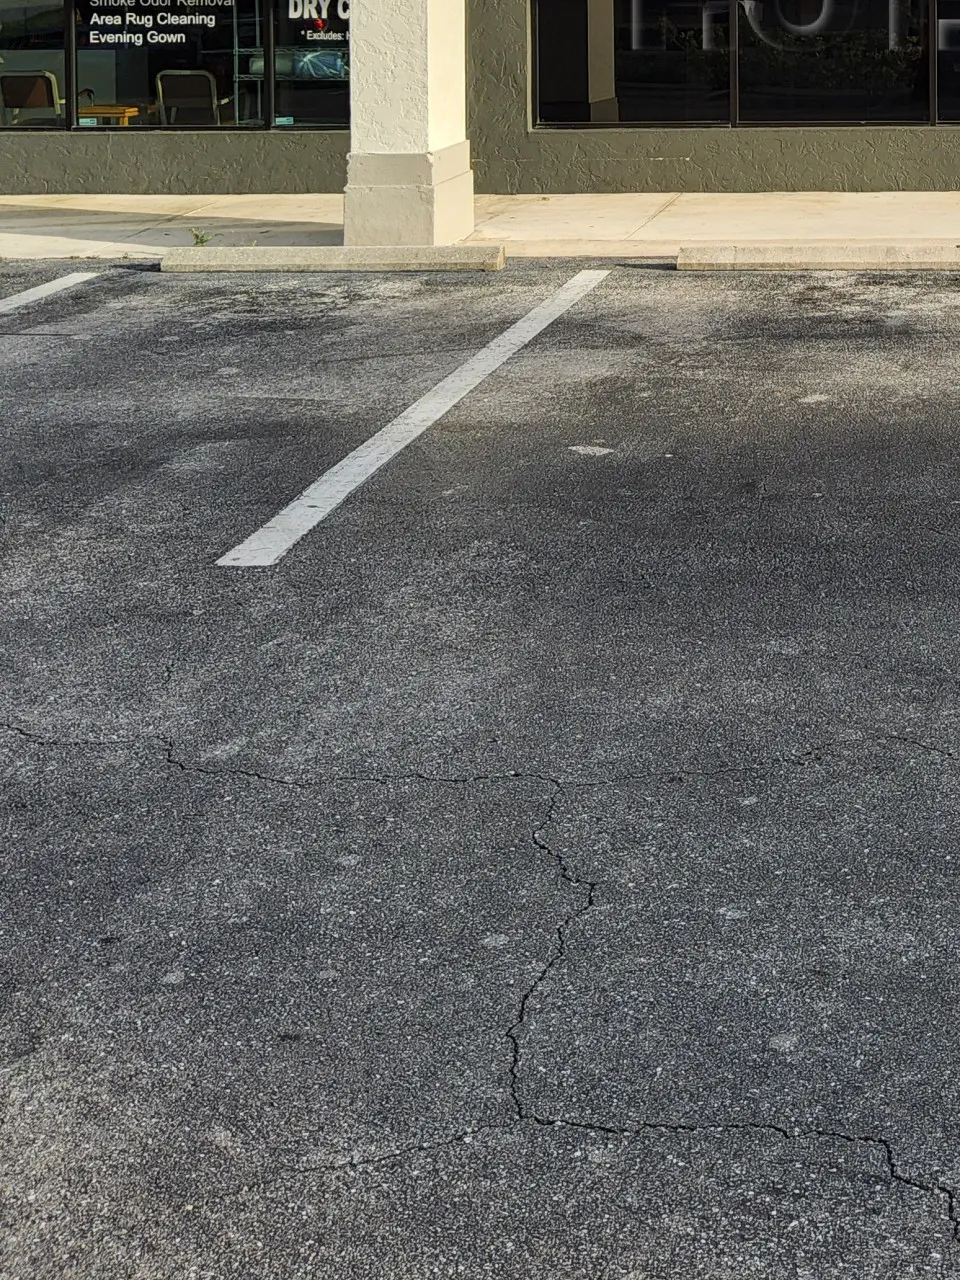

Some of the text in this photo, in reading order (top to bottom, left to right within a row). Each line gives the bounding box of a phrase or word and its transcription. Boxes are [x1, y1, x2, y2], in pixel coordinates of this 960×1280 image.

[90, 12, 216, 27] Area Rug Cleaning
[89, 31, 186, 46] Evening Gown
